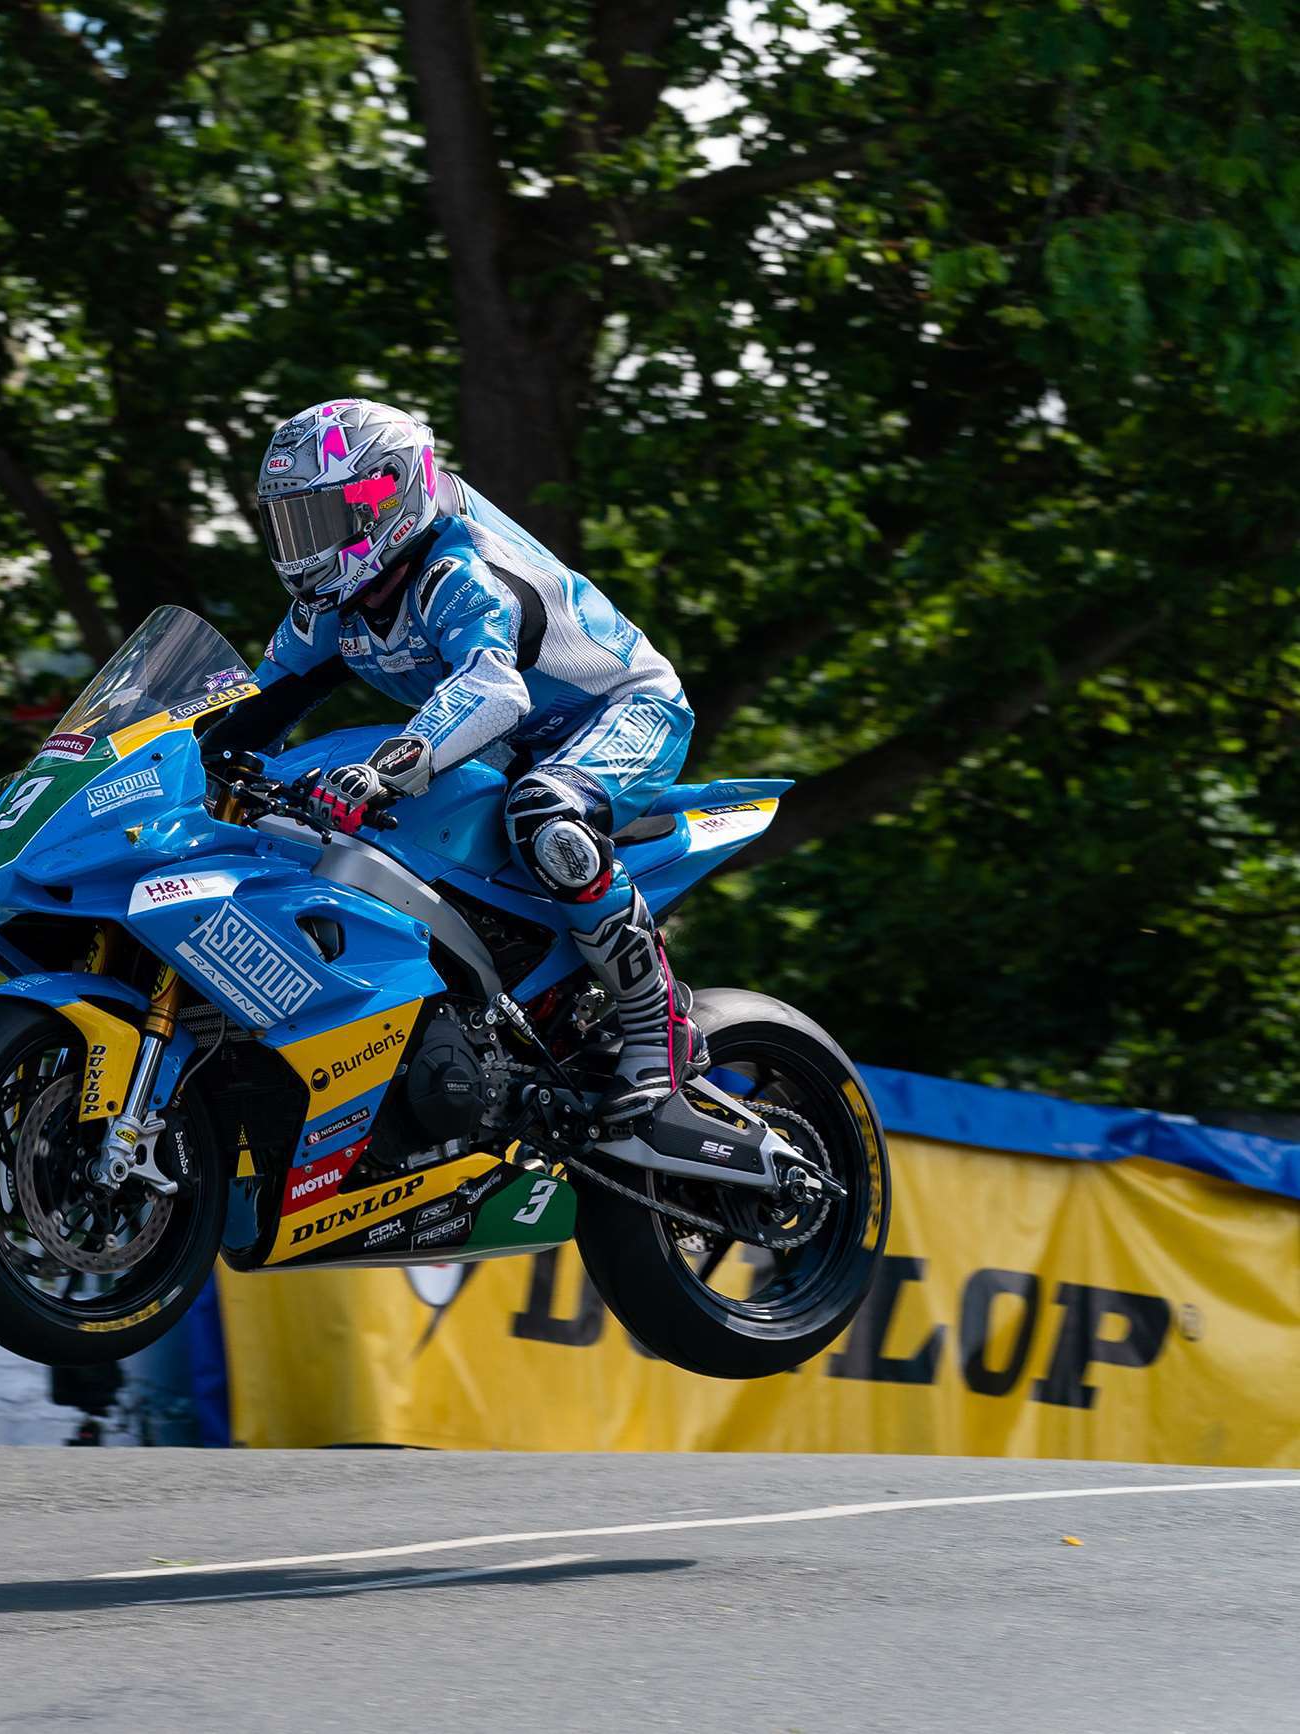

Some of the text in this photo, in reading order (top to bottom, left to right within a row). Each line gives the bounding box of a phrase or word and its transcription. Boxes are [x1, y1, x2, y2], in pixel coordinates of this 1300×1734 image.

[269, 459, 289, 468] BELL
[393, 519, 414, 542] BELL
[44, 739, 85, 751] ennetts
[86, 766, 160, 811] ASHCOURT
[145, 878, 189, 898] H&J
[152, 889, 193, 903] MARTIN
[189, 900, 323, 1019] ASHCOURT
[188, 953, 268, 1026] RACING
[331, 1028, 406, 1080] Burdens
[82, 1044, 107, 1115] DUNLOP
[321, 1119, 350, 1137] NICHOLL
[351, 1109, 368, 1121] OILS
[175, 1131, 189, 1175] brembo
[291, 1168, 342, 1200] MOTUL
[513, 1179, 558, 1225] 3
[290, 1174, 425, 1246] DUNLOP
[368, 1218, 401, 1240] FPH
[363, 1225, 406, 1248] FAIRFAX
[511, 1246, 1171, 1410] DLOP
